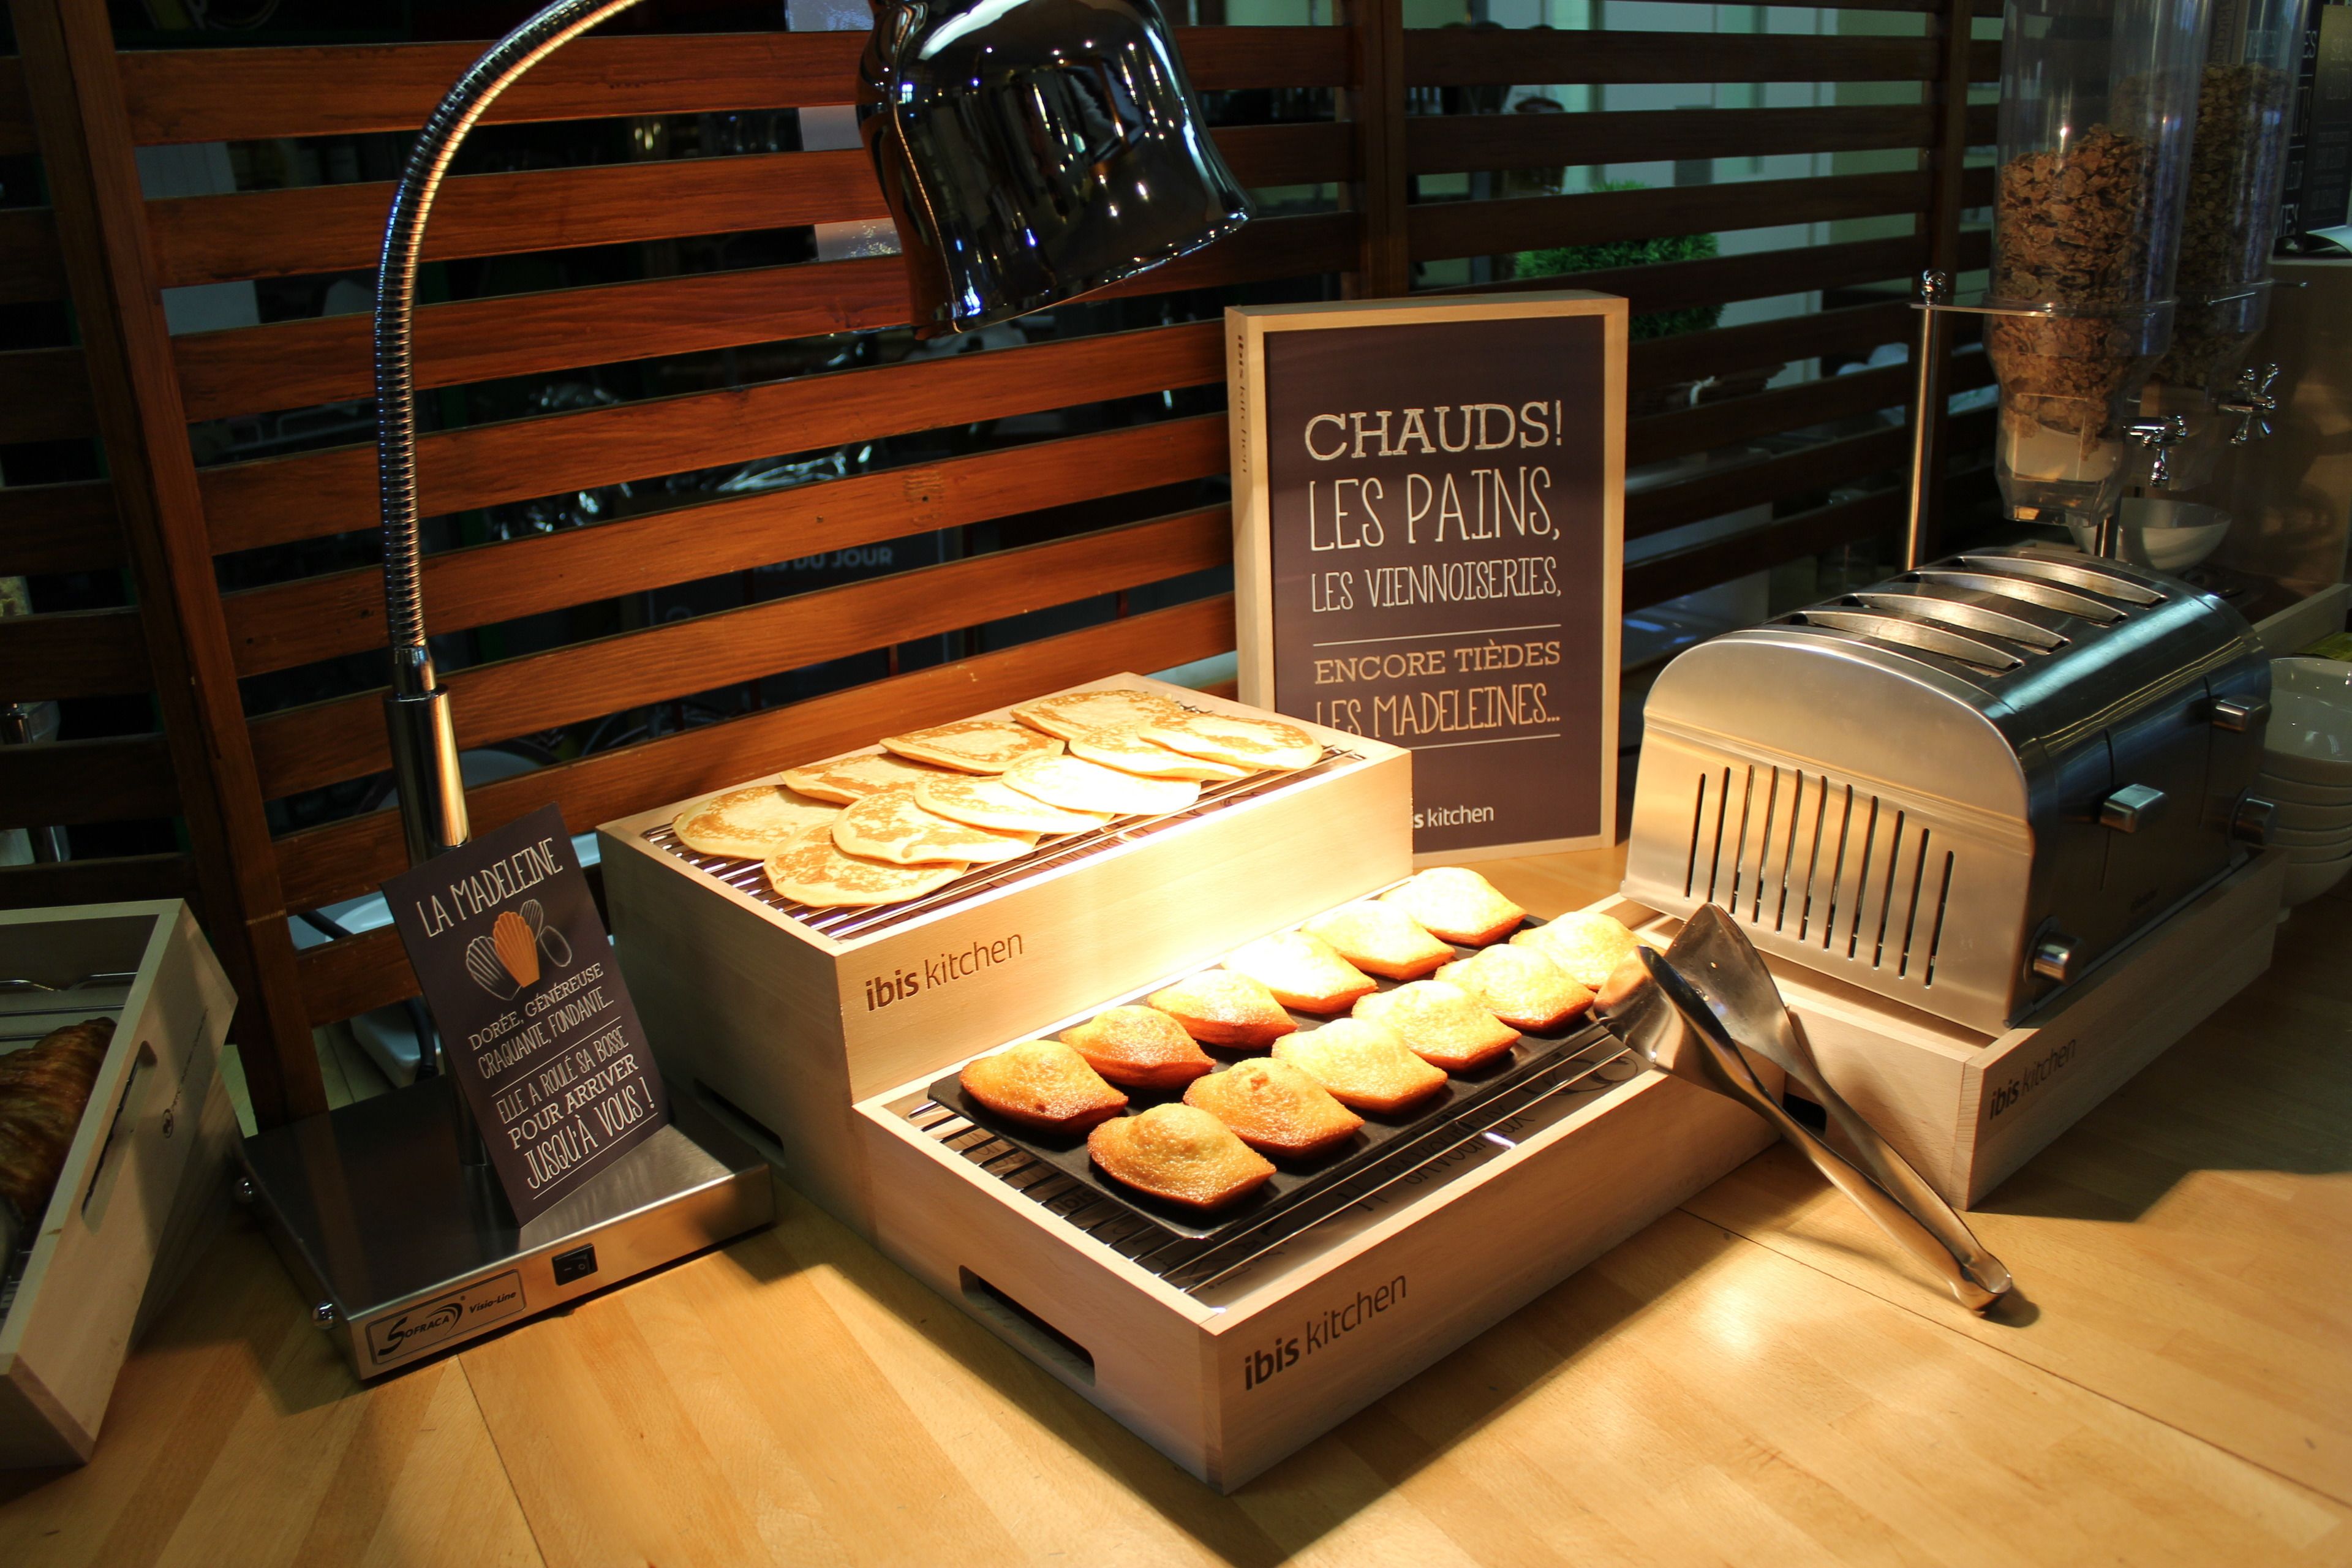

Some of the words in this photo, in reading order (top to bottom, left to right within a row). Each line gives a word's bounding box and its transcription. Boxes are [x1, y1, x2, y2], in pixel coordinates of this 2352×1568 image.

[1304, 399, 1561, 461] CHAUDS!
[1309, 477, 1385, 552] LES
[1406, 466, 1561, 544] PAINS,
[831, 546, 894, 568] JOUR
[1311, 570, 1354, 613] LES
[1364, 555, 1561, 608] VIENNOISERIES,
[1313, 649, 1446, 685] ENCORE
[1454, 638, 1561, 673] TIÈDES
[1316, 698, 1362, 736] LES
[1427, 804, 1495, 827] kitchen
[416, 894, 454, 938] LA
[450, 837, 564, 921] MADELEINE
[865, 969, 919, 1011] ibis
[924, 933, 1023, 990] kitchen
[467, 1010, 525, 1052] DORÉE,
[524, 962, 605, 1018] GÉNÉREUSE
[477, 1022, 552, 1079] CRAQUANTE,
[496, 1088, 529, 1126] ELLE
[527, 1082, 543, 1103] A
[538, 1056, 579, 1098] ROULÉ
[575, 1051, 596, 1074] SA
[593, 1025, 630, 1063] BOSSE
[1988, 1079, 2021, 1121] ibis
[2021, 1038, 2077, 1097] kitchen
[507, 1102, 564, 1150] POUR
[562, 1053, 639, 1115] ARRIVER
[593, 1084, 644, 1138] VOUS
[639, 1076, 656, 1109] !
[377, 1315, 451, 1357] SOFRACA
[469, 1290, 517, 1314] Visio-Line
[1244, 1338, 1300, 1392] ibis
[1306, 1274, 1407, 1355] kitchen
